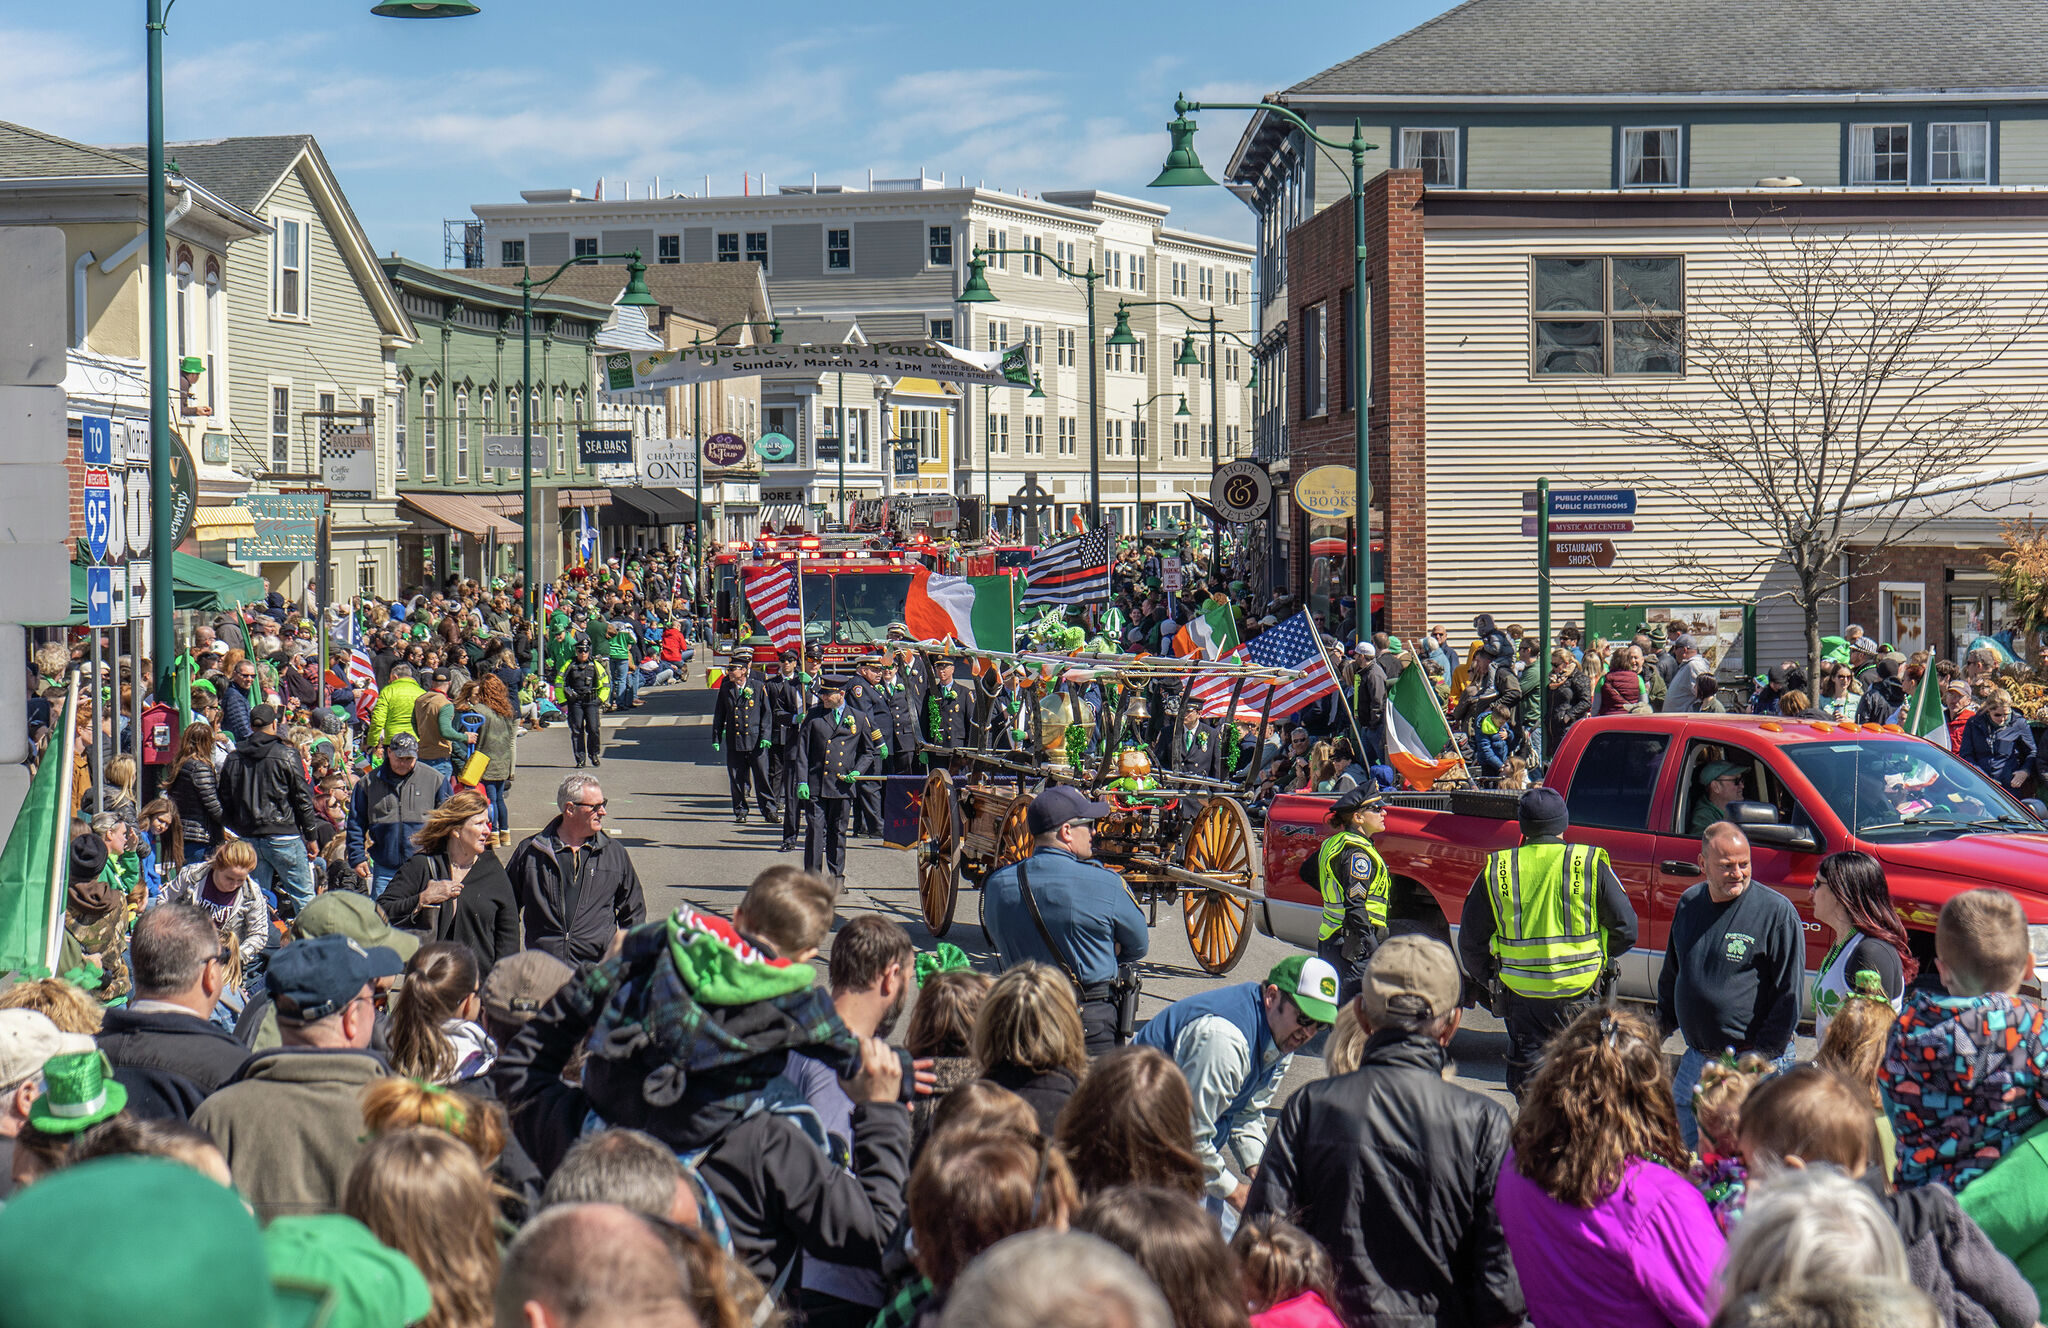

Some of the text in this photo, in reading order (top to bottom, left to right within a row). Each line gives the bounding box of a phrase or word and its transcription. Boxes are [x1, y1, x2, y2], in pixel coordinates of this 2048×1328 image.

[732, 359, 922, 372] Sunday, March 24 1PM
[930, 363, 958, 371] MYSTIC
[967, 371, 996, 380] STREET
[89, 427, 103, 454] TO
[126, 424, 149, 454] NORTH
[585, 440, 627, 454] SEA BAGS
[646, 452, 697, 460] CHAPTER
[647, 462, 697, 480] ONE
[1223, 464, 1257, 478] HOPE
[1227, 478, 1254, 506] &
[1309, 496, 1356, 507] BOOKS
[1214, 500, 1267, 521] STETSON
[87, 499, 108, 544] 95
[1556, 543, 1603, 553] RESTAURANTS
[1568, 555, 1592, 565] SHOPS
